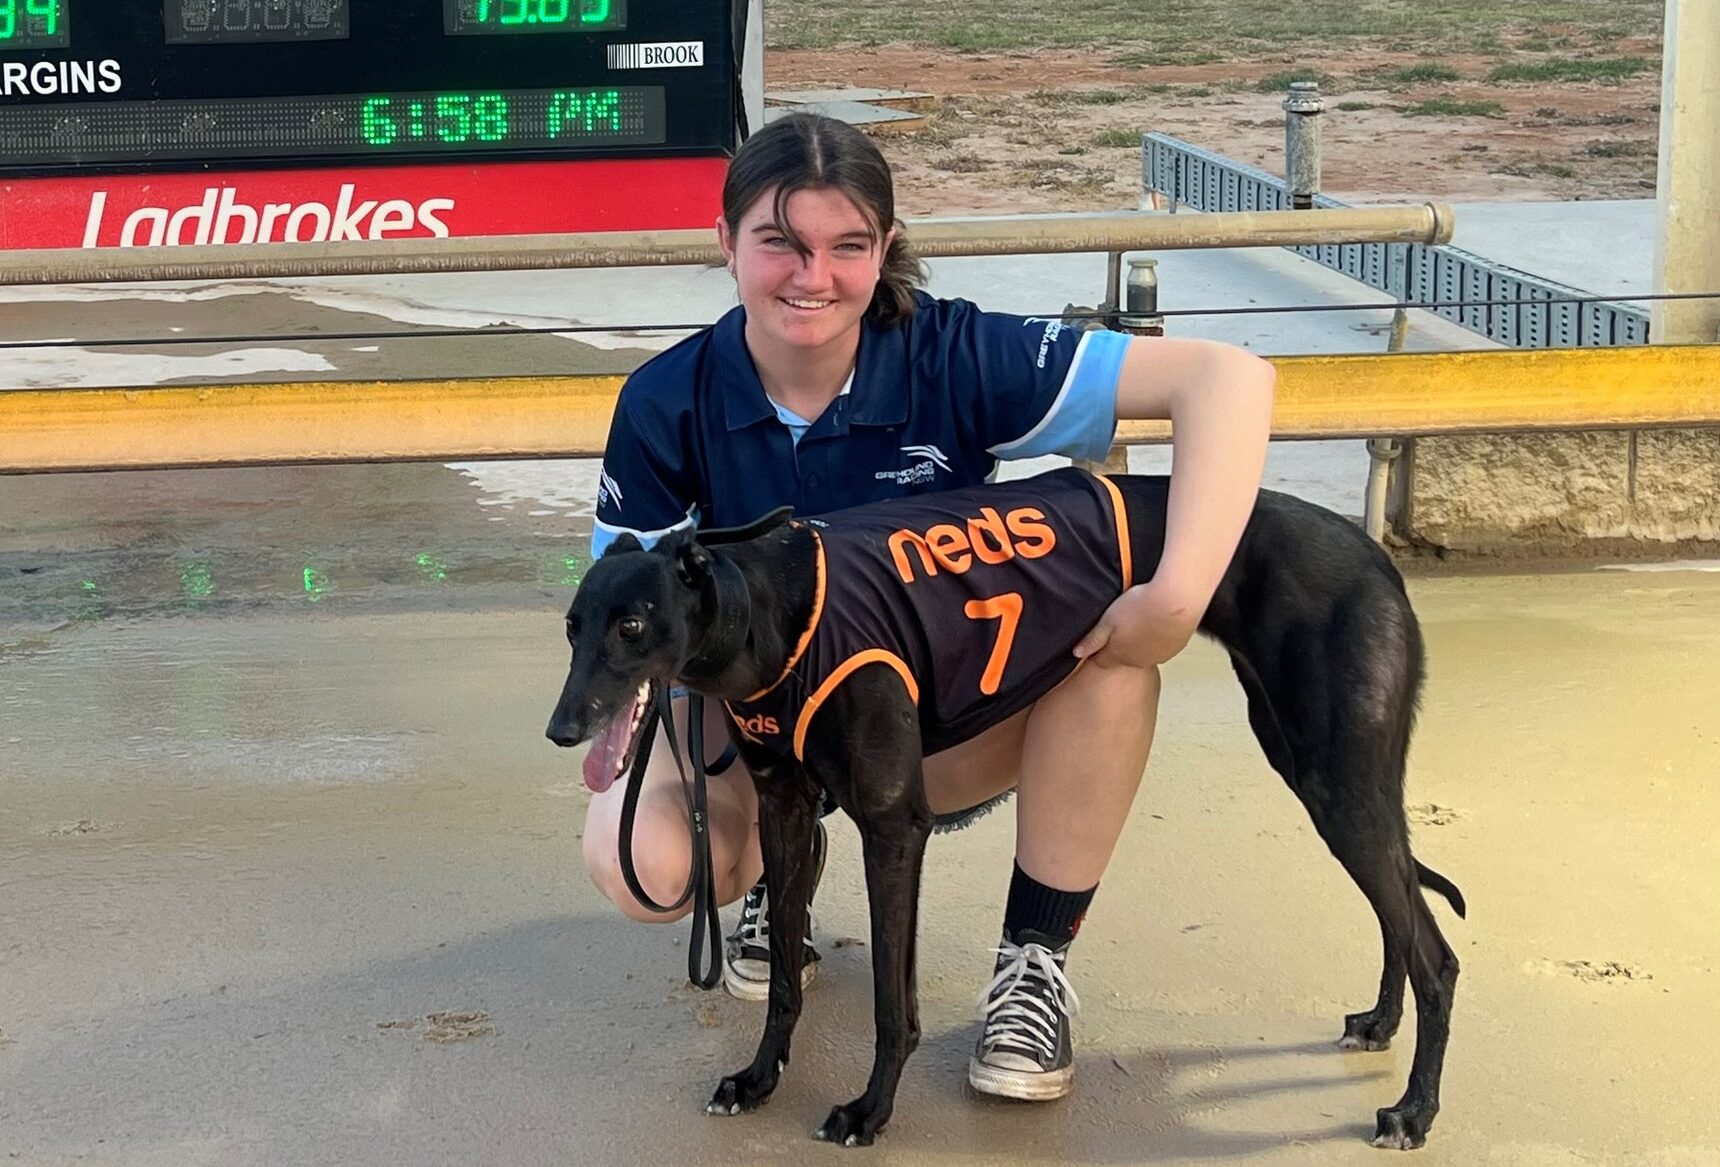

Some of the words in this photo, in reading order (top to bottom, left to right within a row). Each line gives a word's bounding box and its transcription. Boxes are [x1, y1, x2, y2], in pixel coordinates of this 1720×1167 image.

[0, 59, 122, 96] RGINS
[644, 45, 699, 64] BROOK
[363, 95, 508, 145] 6:58
[549, 91, 620, 139] PM
[82, 183, 455, 249] Ladbrokes
[888, 507, 1057, 583] neds
[964, 592, 1024, 696] 7
